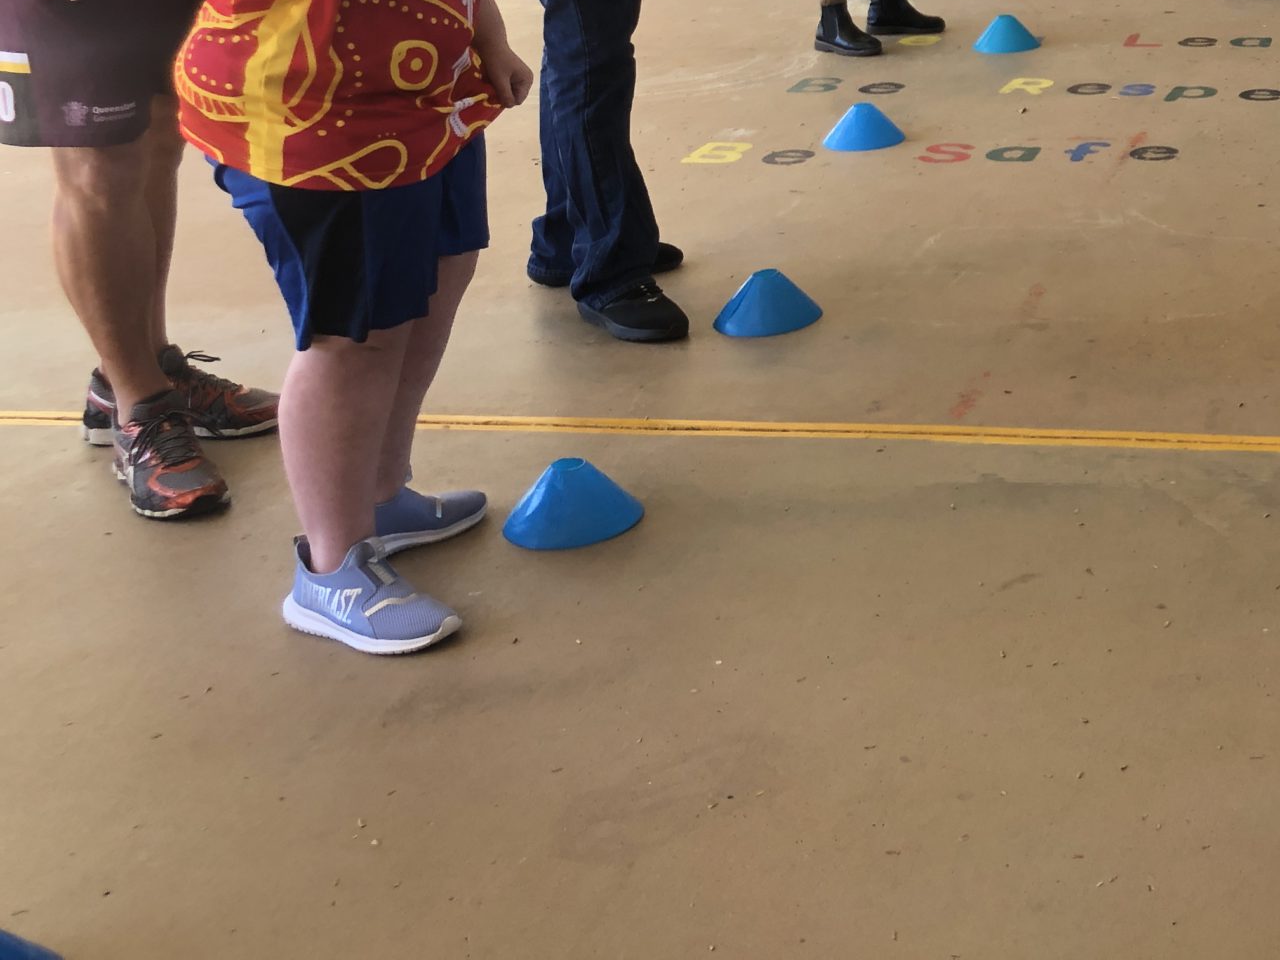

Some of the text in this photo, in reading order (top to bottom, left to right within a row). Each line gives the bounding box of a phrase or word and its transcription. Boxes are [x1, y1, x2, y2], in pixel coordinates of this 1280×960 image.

[789, 77, 905, 95] Be
[681, 141, 1179, 165] Be Safe
